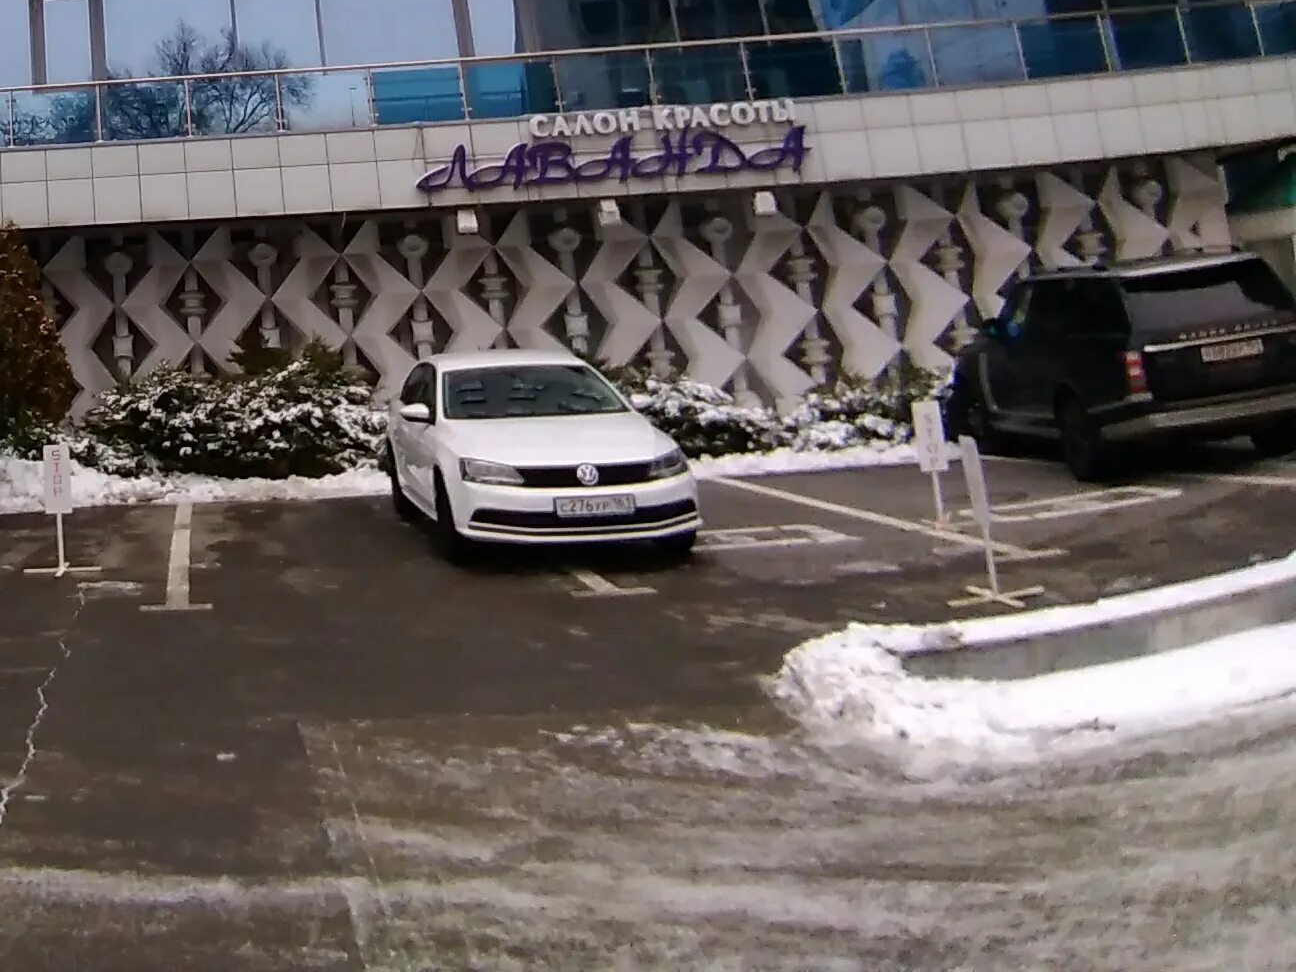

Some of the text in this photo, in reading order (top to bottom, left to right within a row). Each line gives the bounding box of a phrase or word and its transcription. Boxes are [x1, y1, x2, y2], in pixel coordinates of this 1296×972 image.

[530, 100, 796, 139] САЛОН КРАСОТЫ
[416, 125, 812, 191] ЛАВАНДА
[51, 449, 62, 497] STOP
